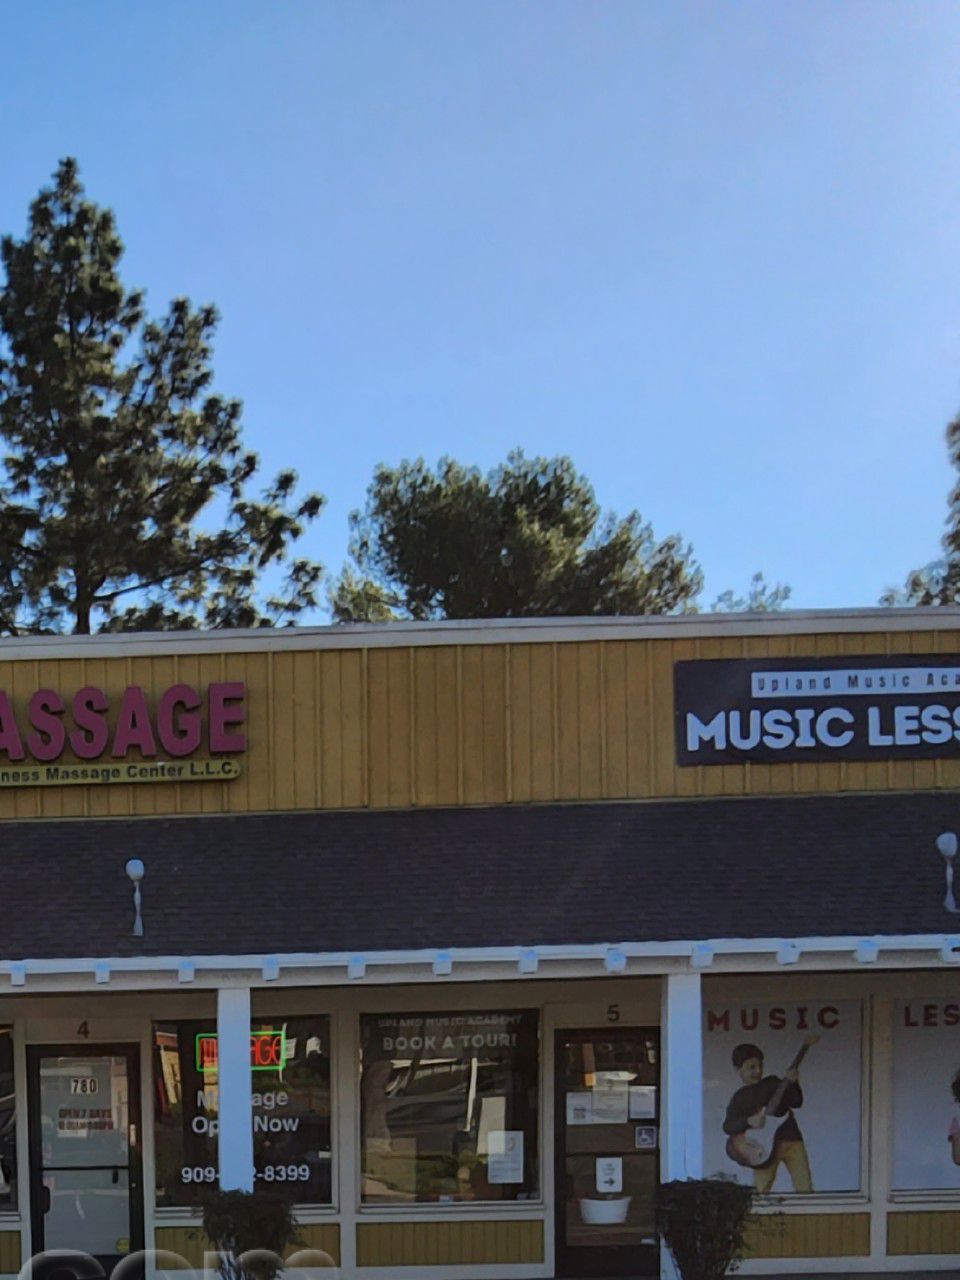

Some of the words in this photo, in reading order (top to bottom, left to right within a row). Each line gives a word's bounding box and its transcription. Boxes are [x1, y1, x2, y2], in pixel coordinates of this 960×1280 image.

[757, 676, 832, 692] Upland
[847, 674, 910, 689] Music
[686, 706, 855, 751] MUSIC
[867, 704, 960, 746] LES
[45, 765, 120, 782] Massage
[127, 763, 184, 778] Center
[190, 761, 238, 776] L.L.C.
[607, 1004, 620, 1023] 5
[707, 1006, 840, 1032] MUSIC
[76, 1021, 90, 1039] 4
[383, 1036, 436, 1051] BOOK
[442, 1035, 455, 1049] A
[462, 1033, 517, 1048] TOUR!
[73, 1079, 97, 1093] 780
[253, 1115, 300, 1133] Now
